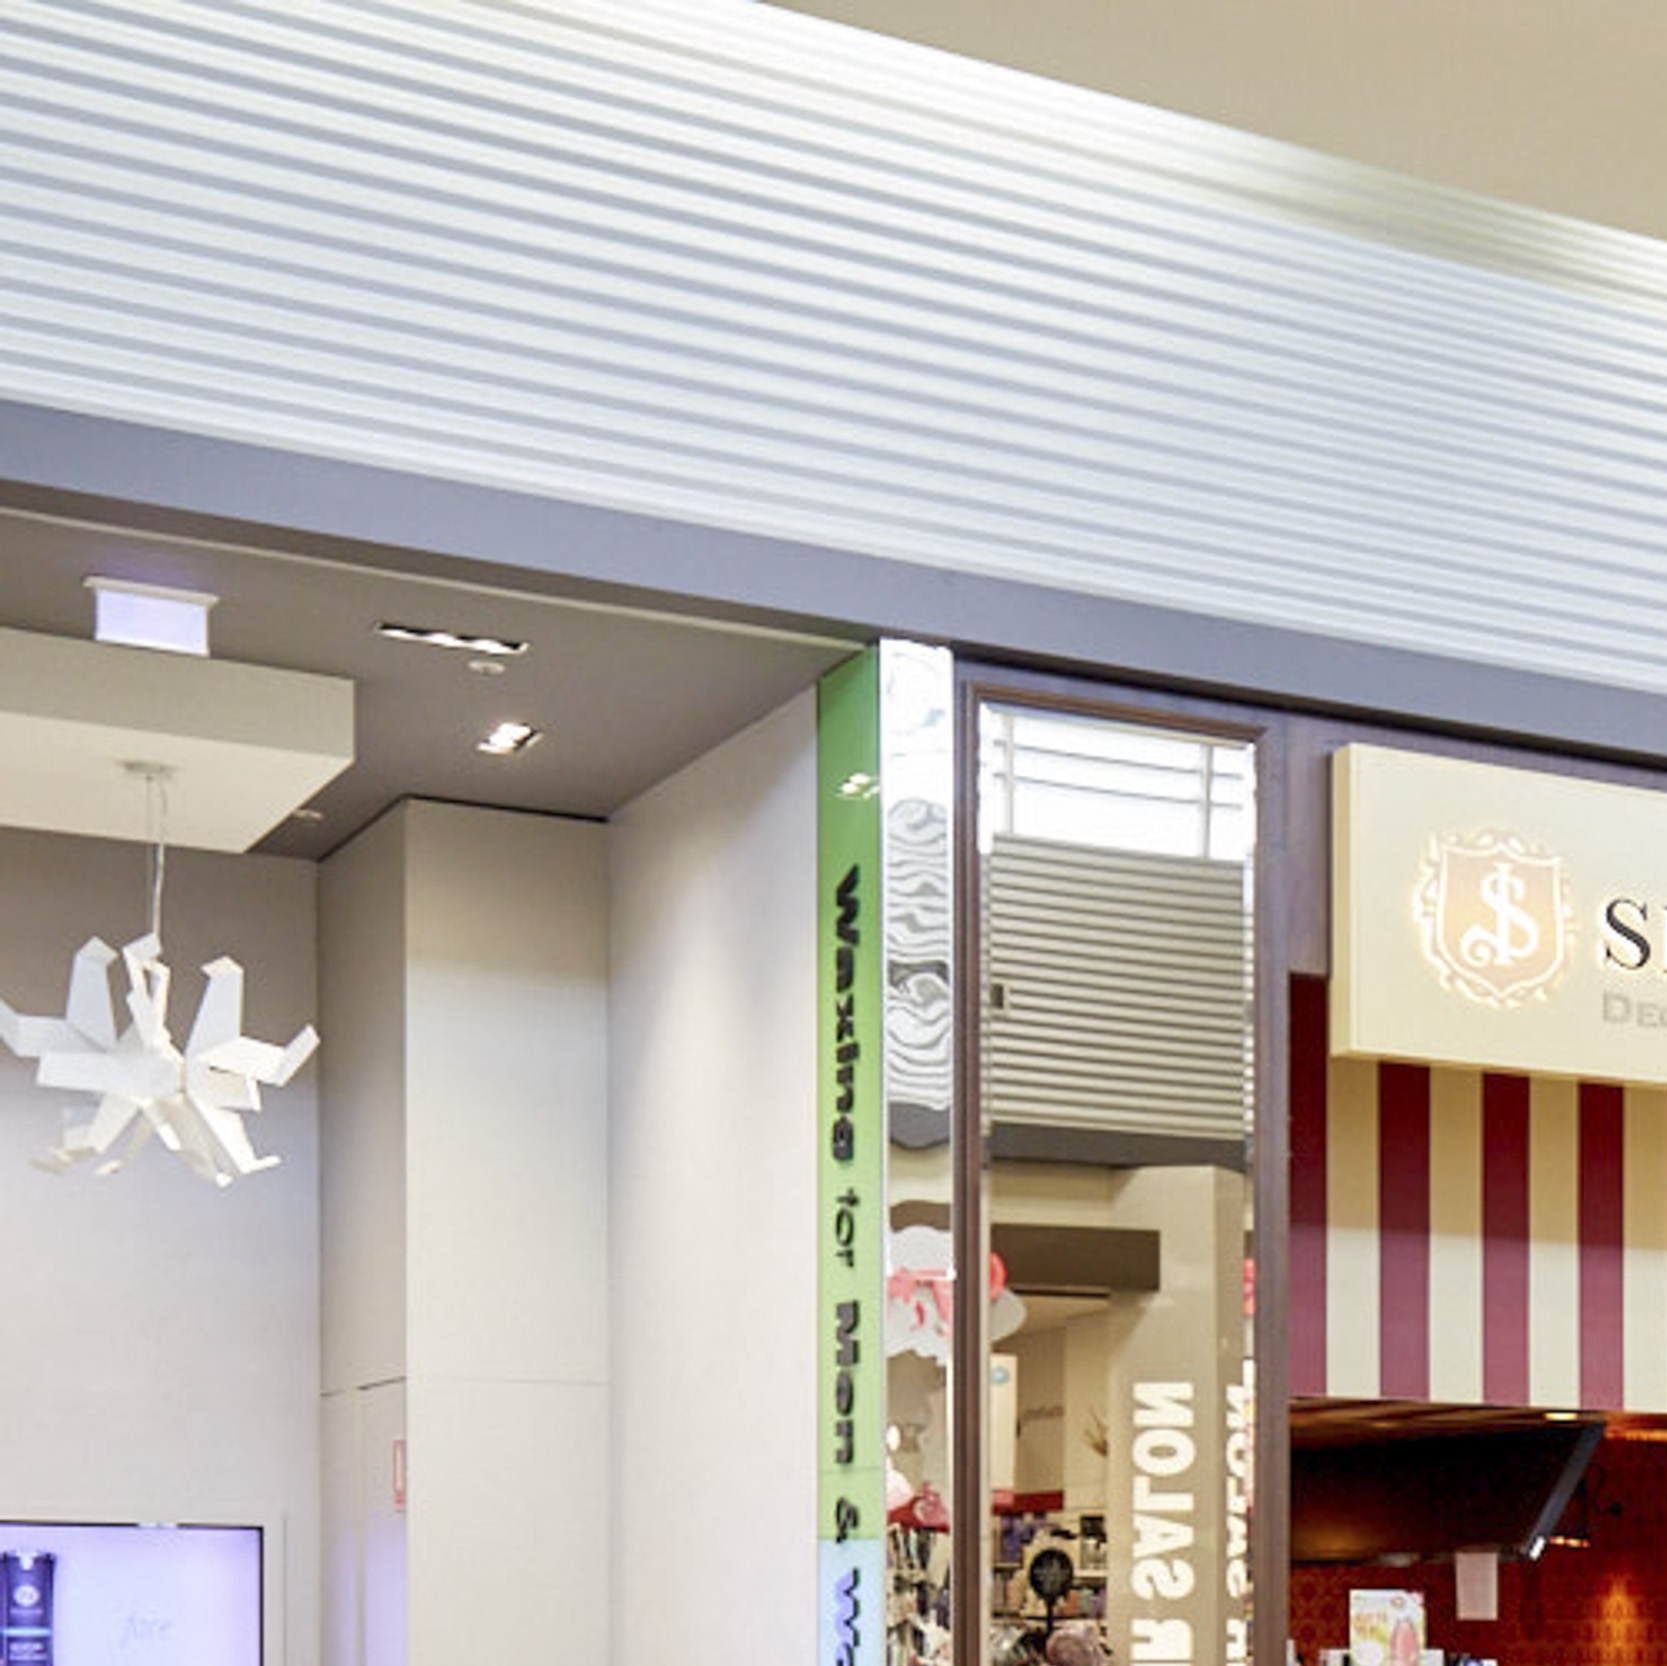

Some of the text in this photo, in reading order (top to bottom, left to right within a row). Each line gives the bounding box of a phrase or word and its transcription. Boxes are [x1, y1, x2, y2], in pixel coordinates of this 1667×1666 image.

[833, 863, 860, 1164] Waxing
[834, 1187, 860, 1268] for
[835, 1496, 858, 1545] &
